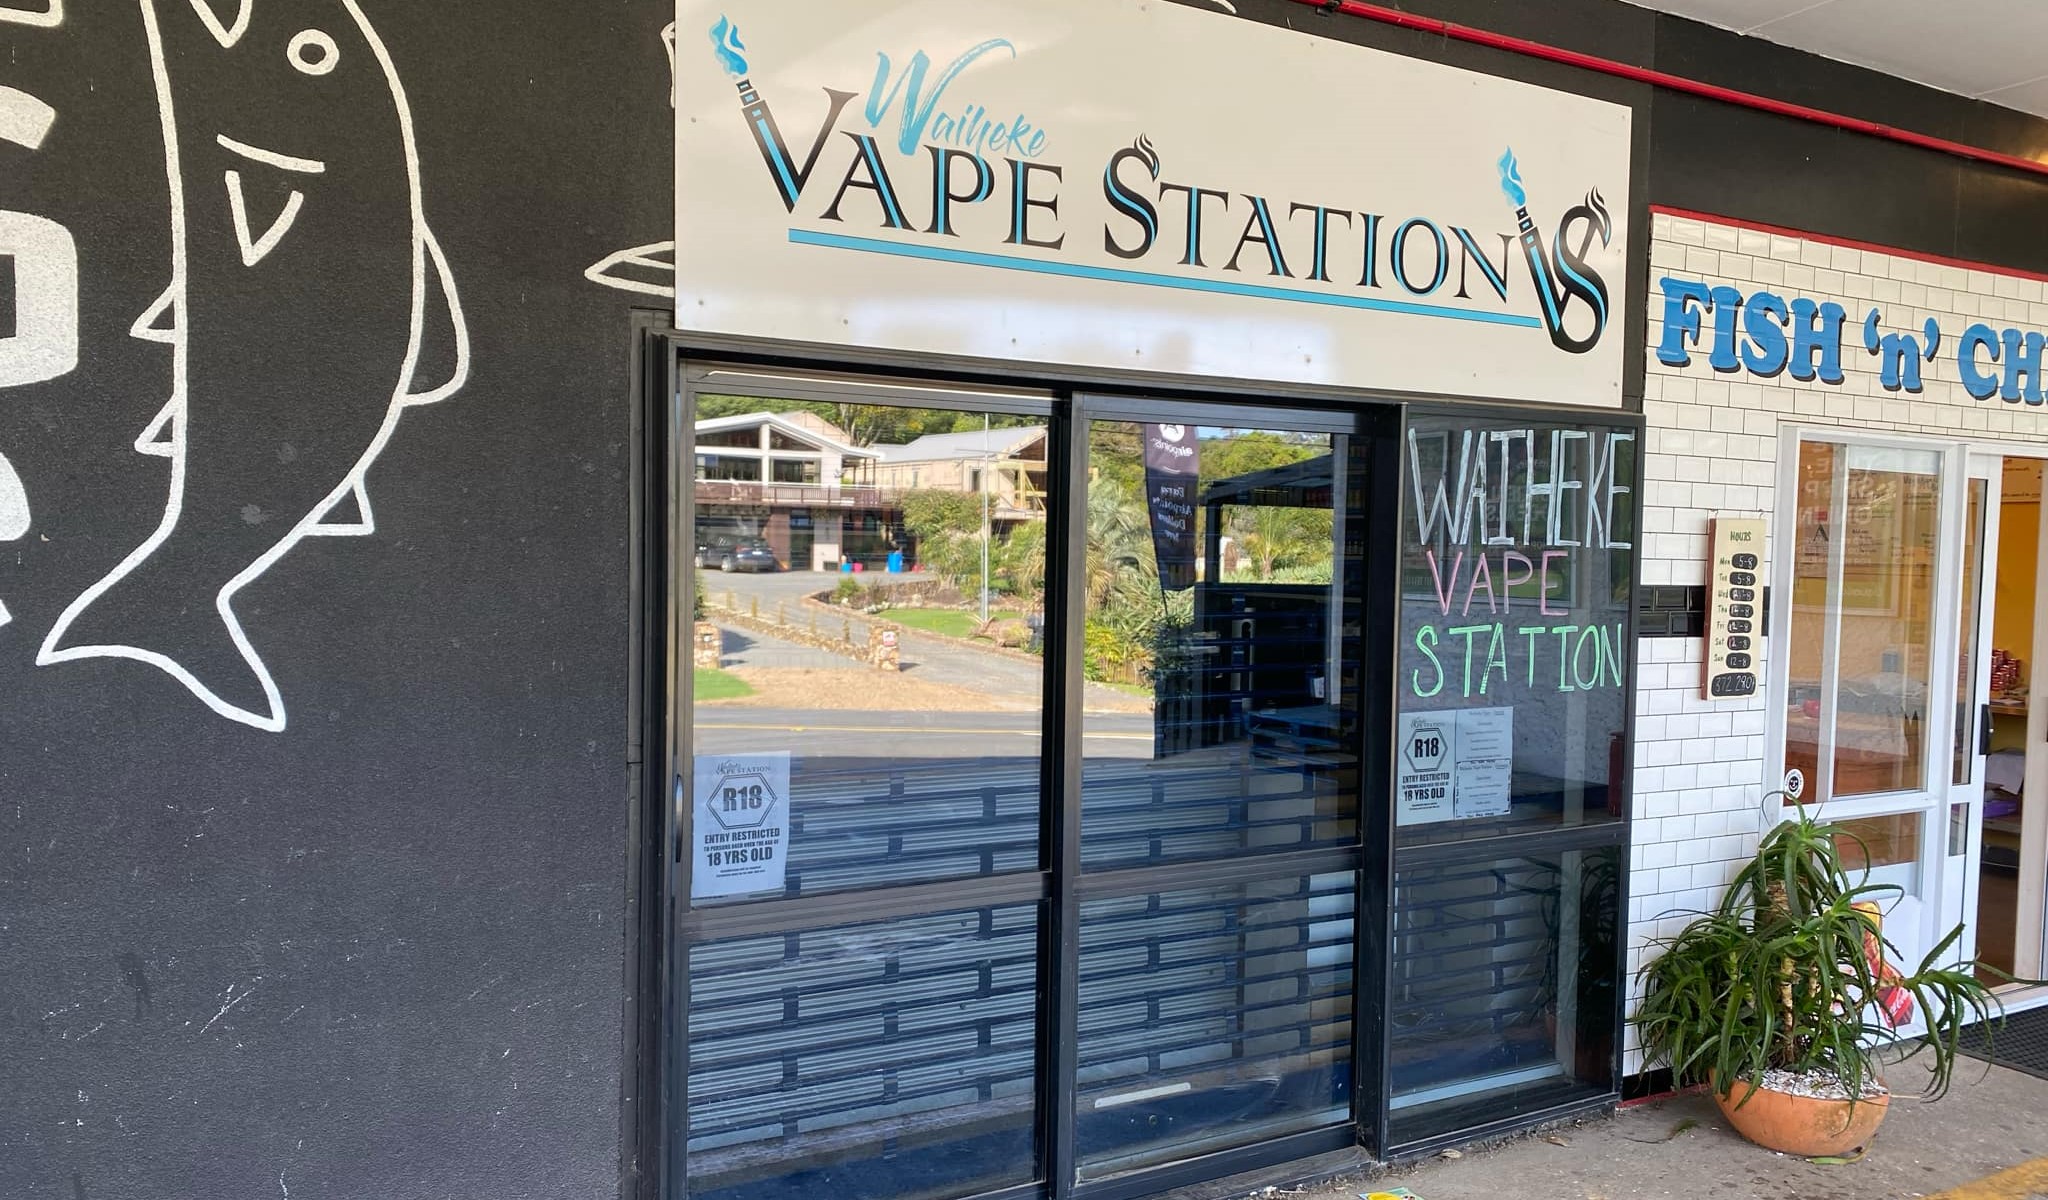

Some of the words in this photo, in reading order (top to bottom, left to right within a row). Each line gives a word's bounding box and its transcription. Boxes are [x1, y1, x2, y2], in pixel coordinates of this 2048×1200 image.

[863, 38, 1048, 159] Waiheke
[735, 78, 1066, 250] VAPE
[1103, 132, 1516, 304] STATION
[1656, 276, 1848, 386] FISH
[1958, 323, 2048, 406] CH
[1408, 427, 1635, 550] WAIHEKE
[1730, 531, 1752, 541] HOURS
[1426, 550, 1568, 617] VAPE
[1412, 622, 1622, 698] STATION
[1414, 737, 1440, 758] R18
[1402, 774, 1418, 784] ENTRY
[1419, 772, 1450, 782] RESTRICTED
[722, 785, 762, 812] R18
[1415, 788, 1429, 800] YRS
[1430, 787, 1445, 799] OLD
[704, 832, 729, 844] ENTRY
[732, 827, 780, 841] RESTRICTED
[707, 852, 721, 867] 18
[724, 849, 748, 864] YRS
[751, 846, 773, 862] OLD
